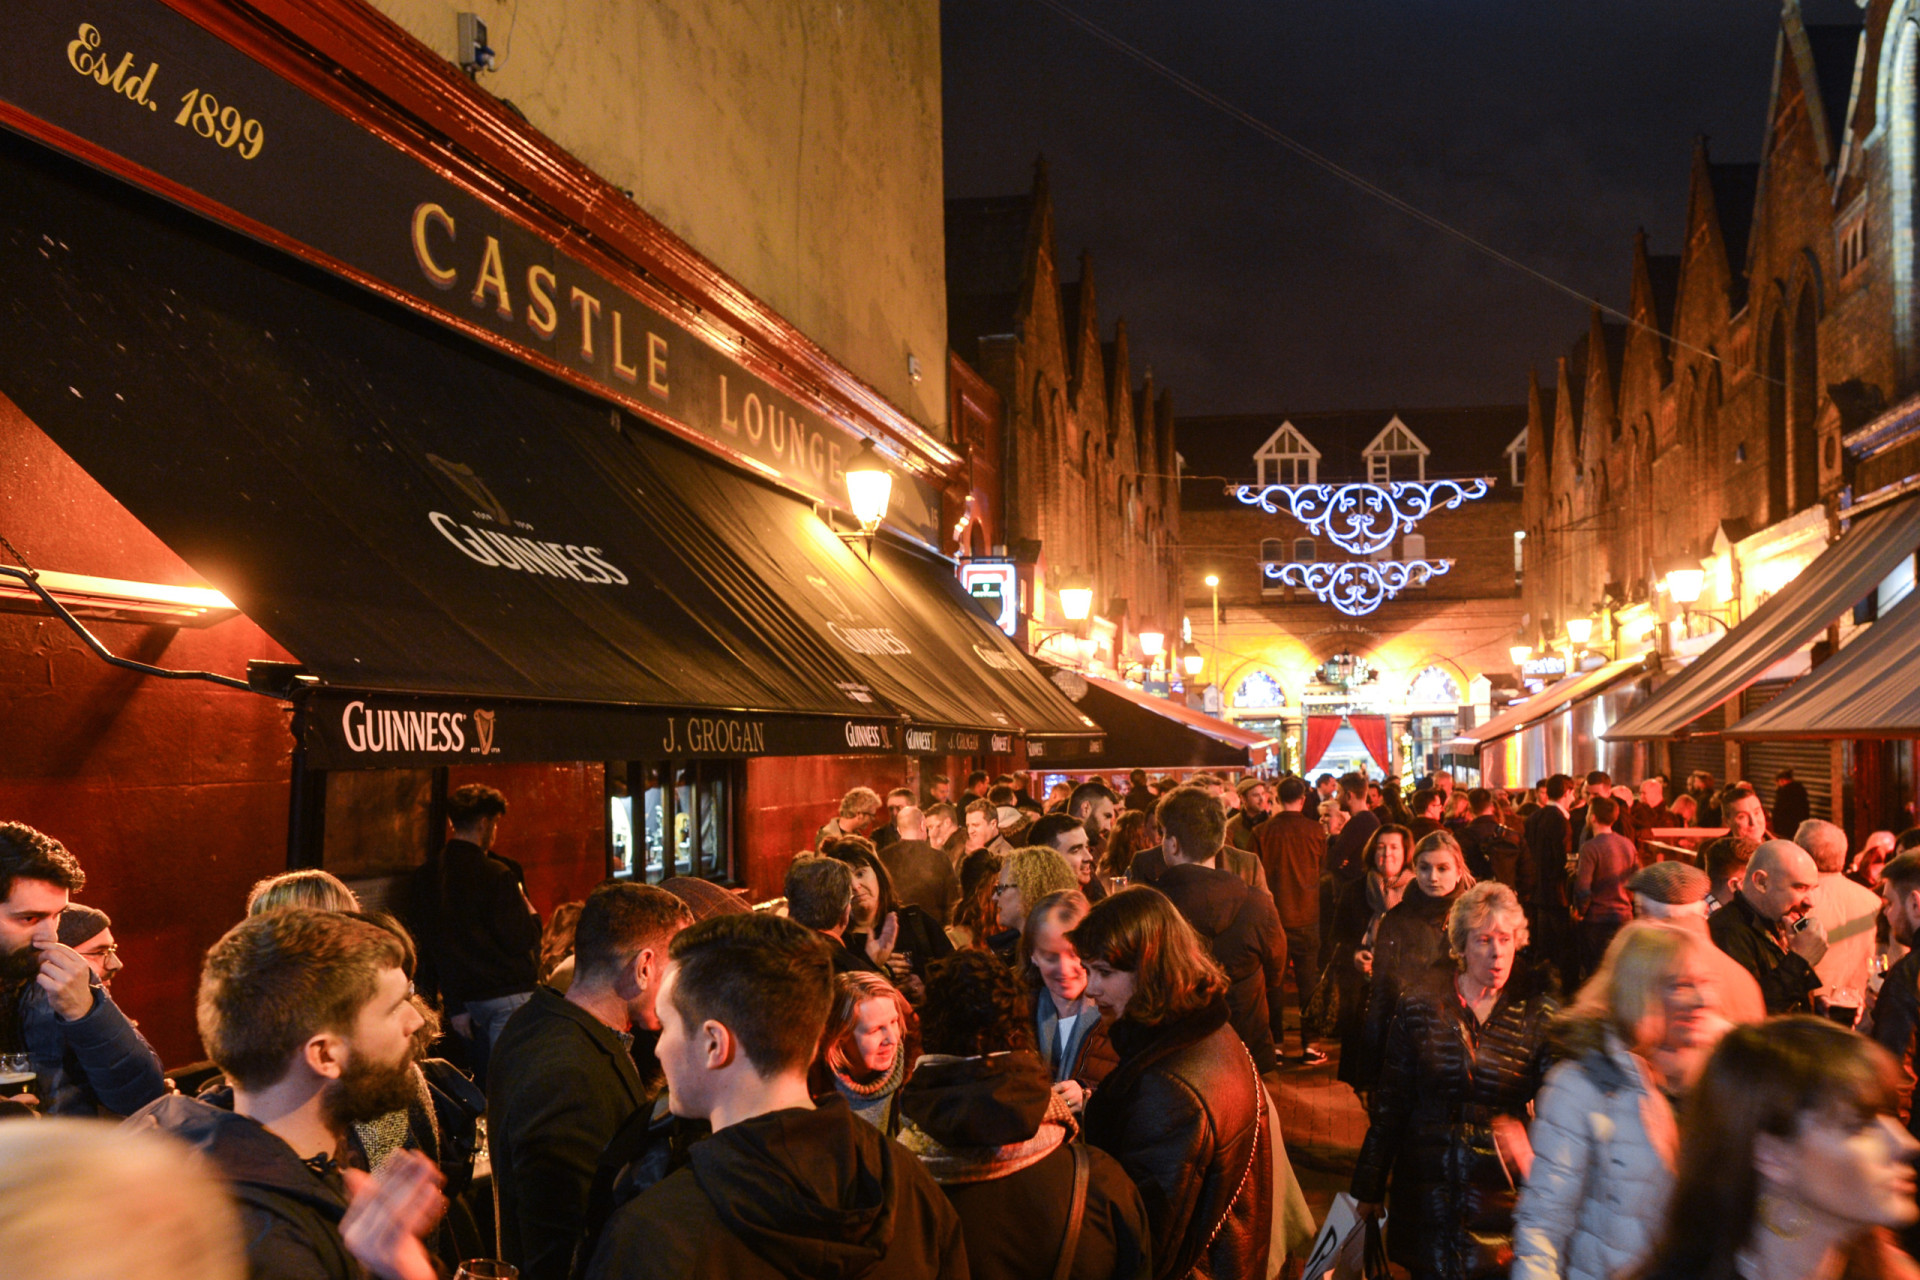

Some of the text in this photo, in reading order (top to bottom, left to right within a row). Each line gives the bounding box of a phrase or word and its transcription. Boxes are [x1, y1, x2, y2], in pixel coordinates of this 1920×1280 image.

[67, 22, 265, 161] Estd. 1899
[411, 202, 845, 486] CASTLE LOUNGE
[428, 510, 630, 586] GUINNESS
[341, 700, 465, 753] GUINNESS
[663, 717, 765, 753] J. GROGAN
[845, 721, 881, 748] GUINNESS
